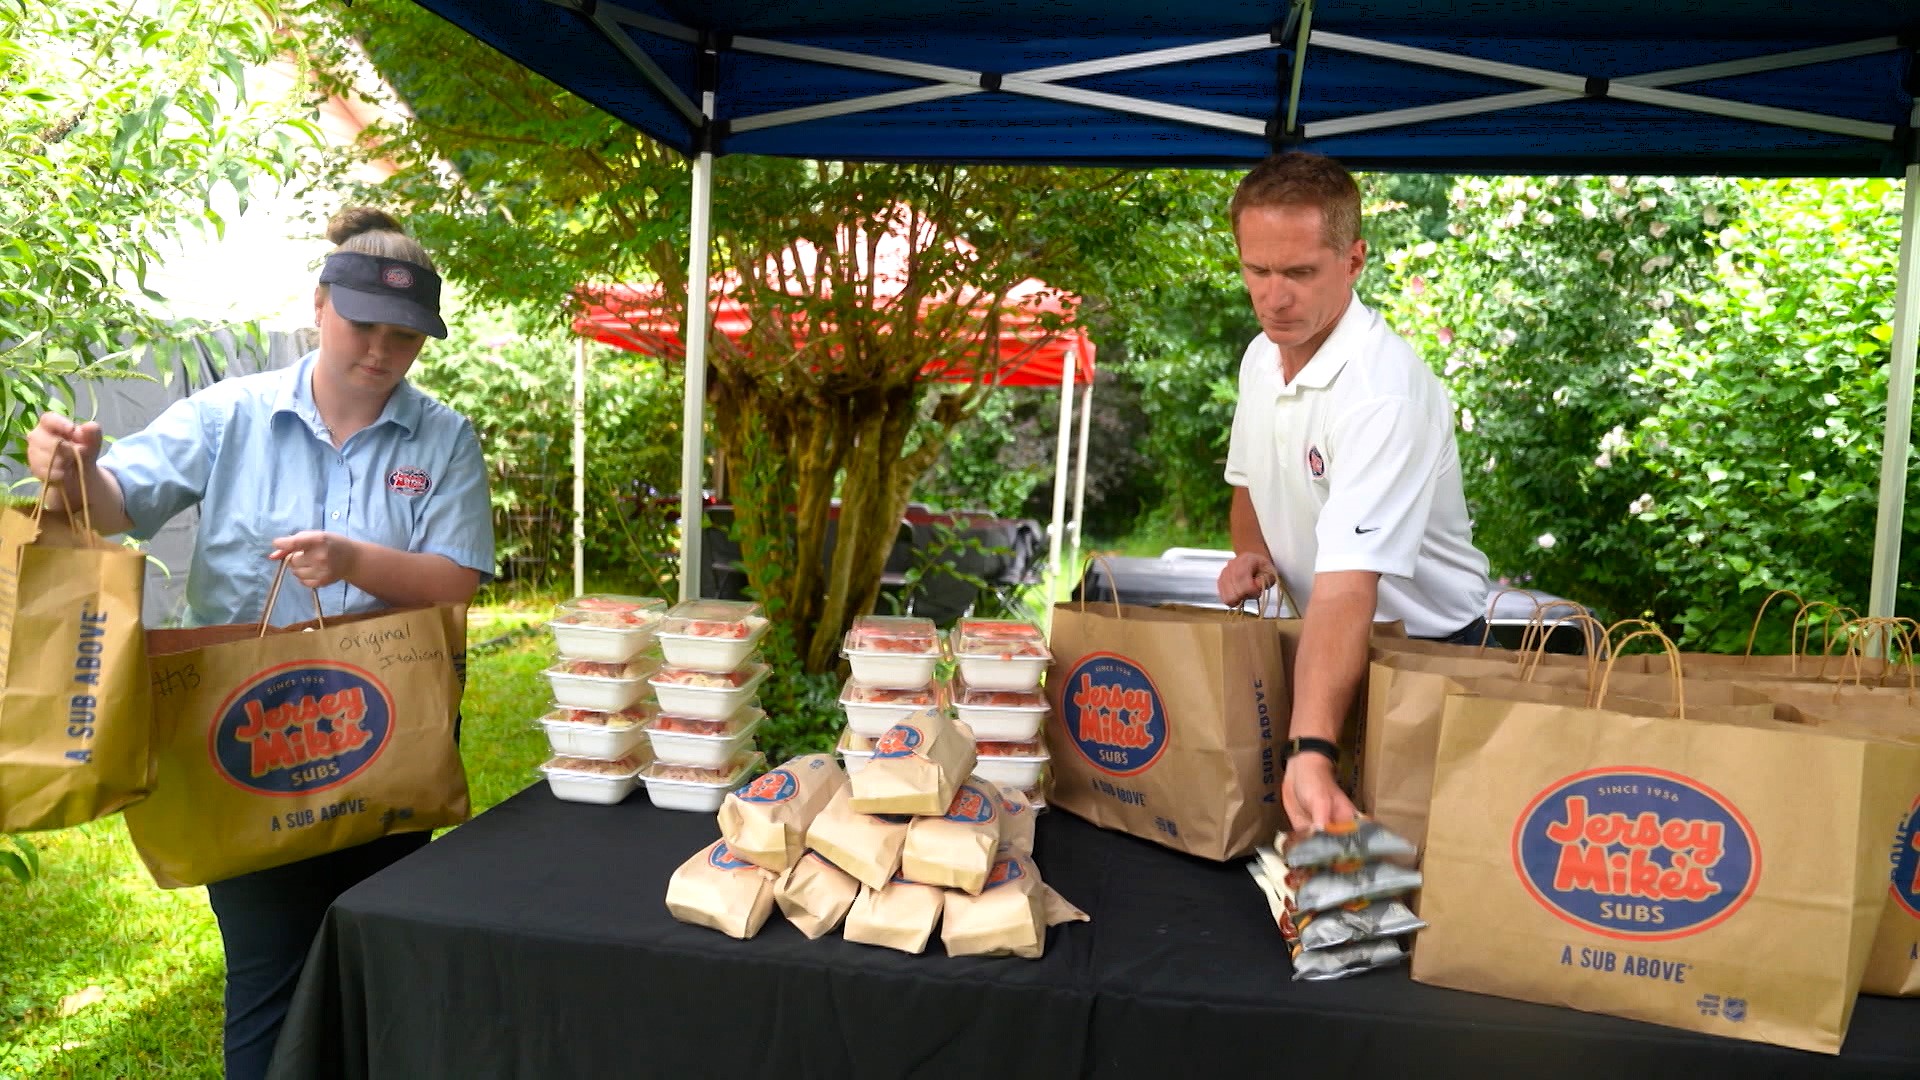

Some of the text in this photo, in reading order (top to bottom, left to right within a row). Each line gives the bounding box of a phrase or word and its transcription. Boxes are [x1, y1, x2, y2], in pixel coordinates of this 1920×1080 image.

[68, 695, 96, 738] SUB
[235, 687, 368, 743] Jersey
[1073, 673, 1154, 722] Jersey
[251, 718, 373, 778] Mike's
[1079, 706, 1154, 749] Mike's
[1254, 679, 1275, 803] A SUB ABOVE
[65, 750, 92, 764] A
[291, 761, 341, 786] SUBS
[1099, 750, 1129, 765] SUBS
[1598, 785, 1680, 802] SINCE 1956
[271, 815, 281, 832] A
[287, 809, 315, 828] SUB
[320, 799, 367, 822] ABOVE
[1546, 796, 1725, 867] Jersey
[1553, 844, 1722, 902] Mike's
[1599, 902, 1665, 924] SUBS
[1561, 945, 1686, 983] A SUB ABOVE
